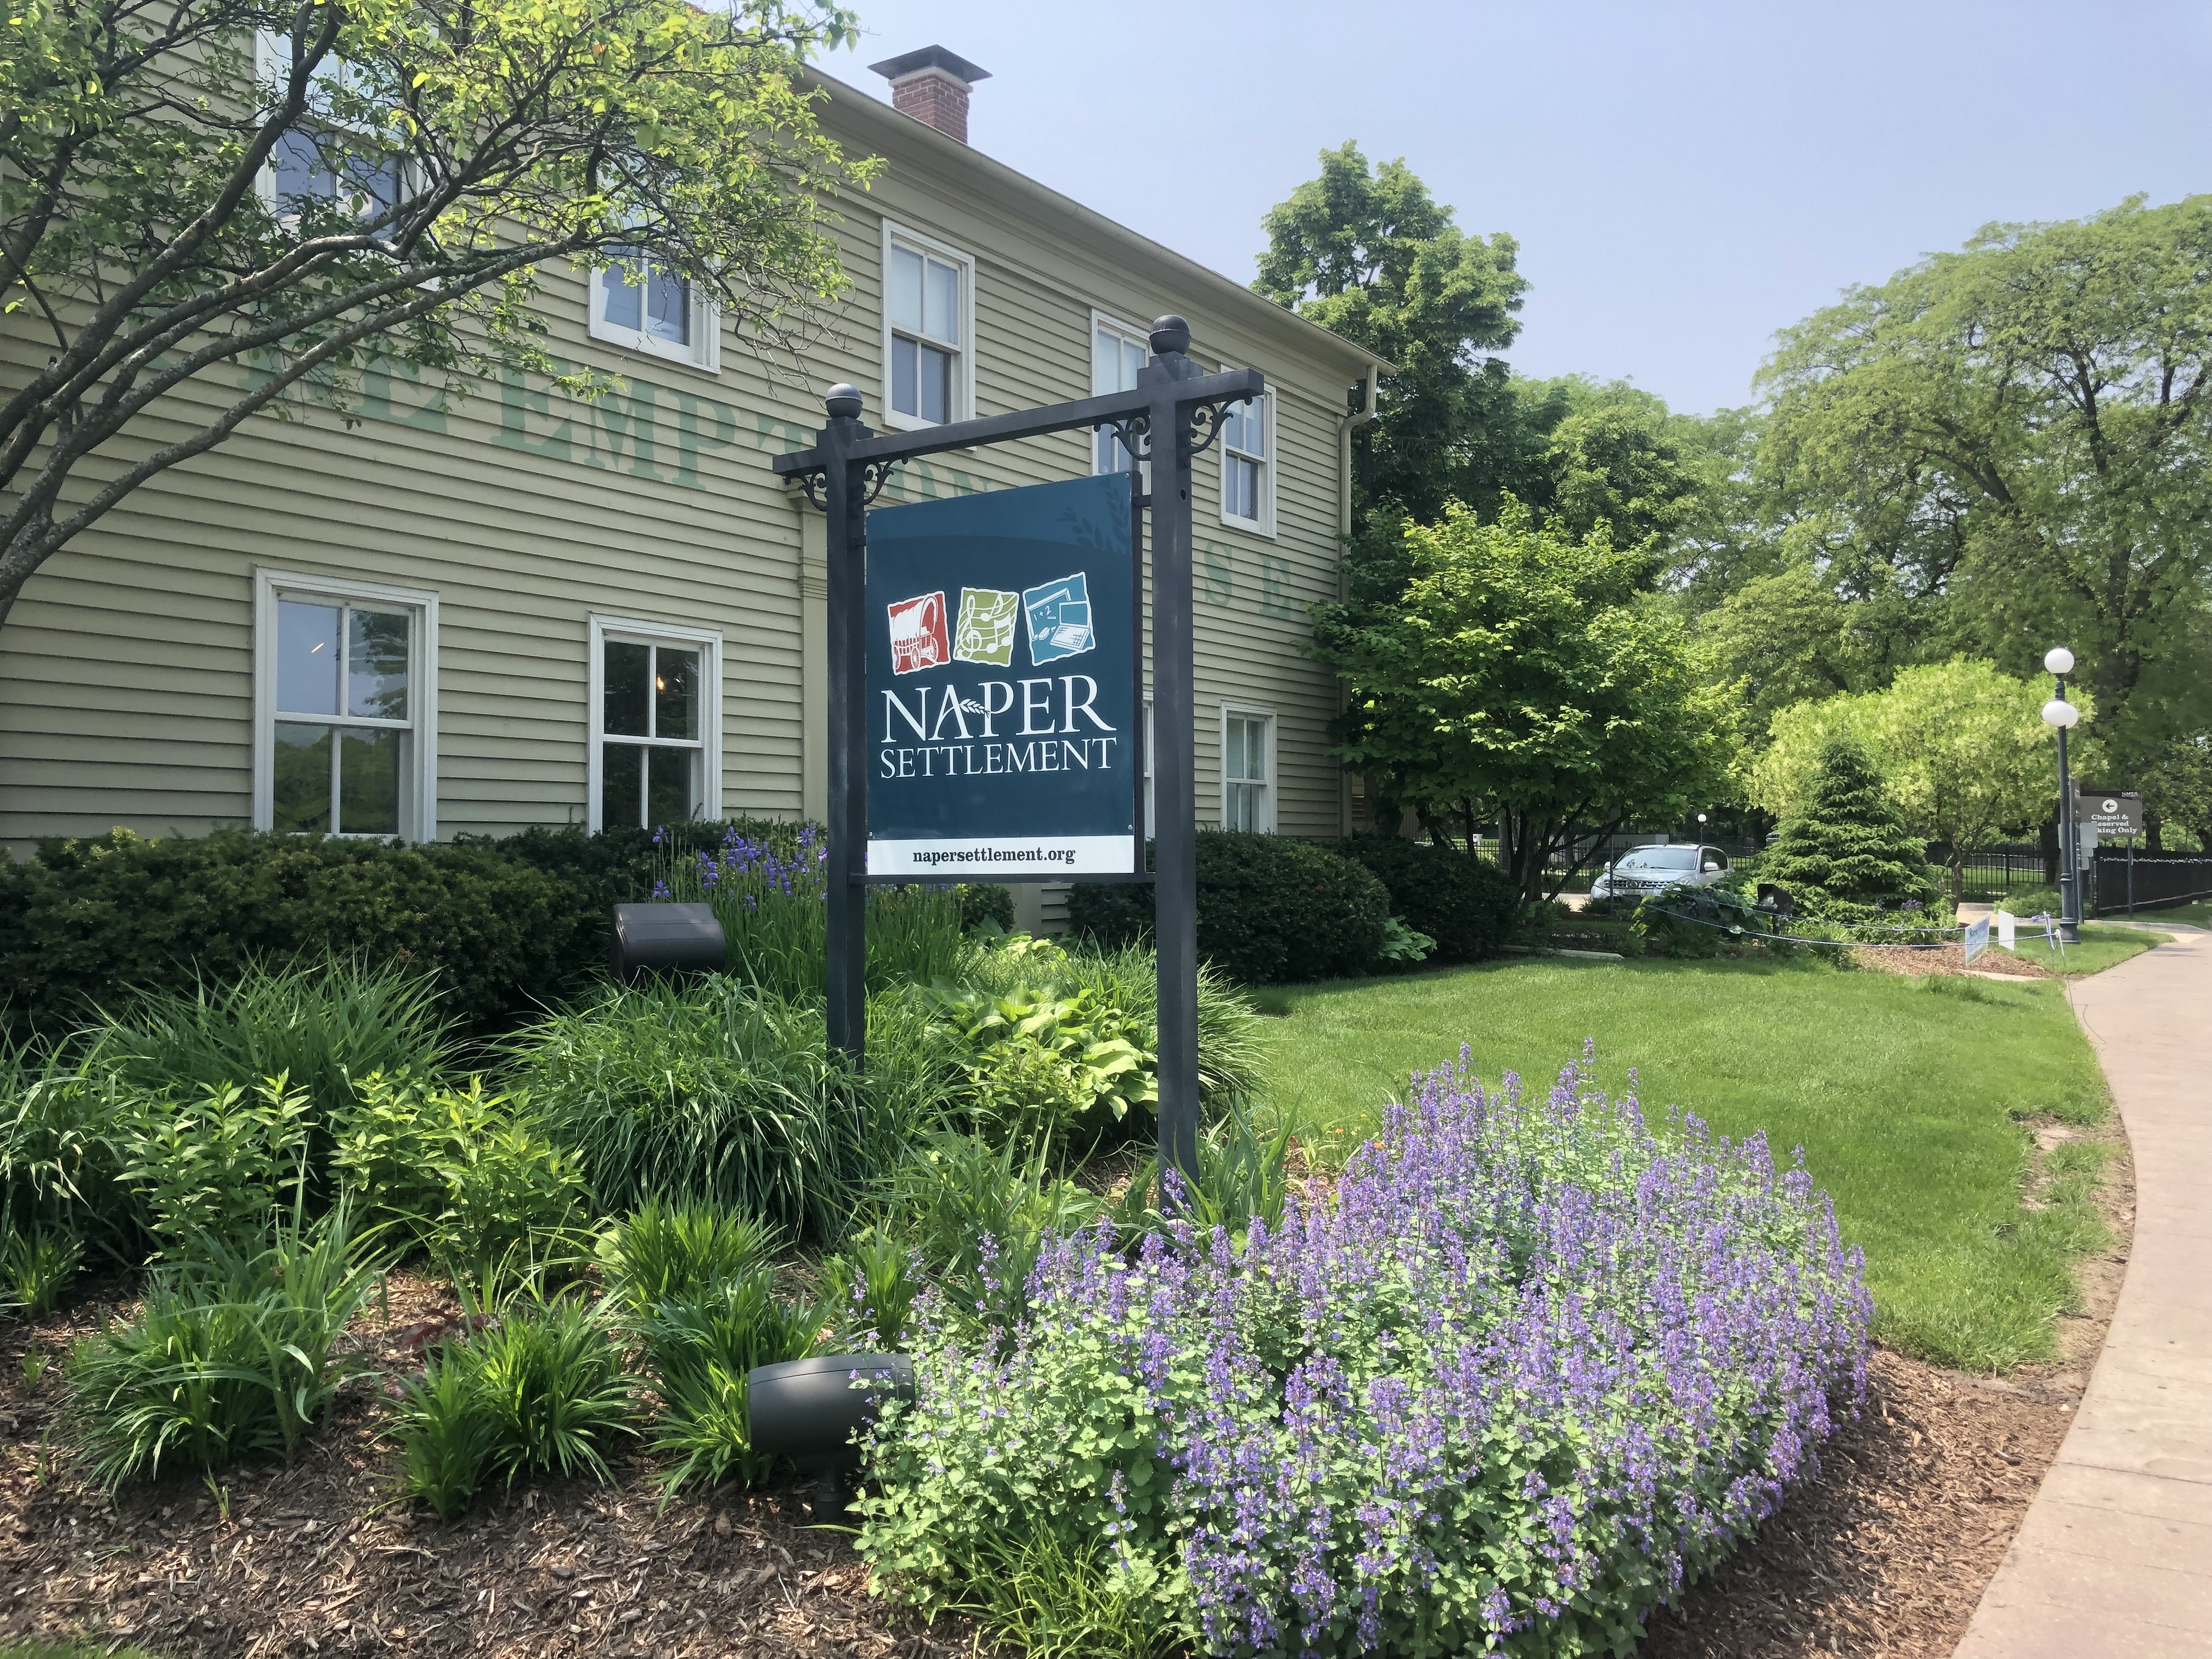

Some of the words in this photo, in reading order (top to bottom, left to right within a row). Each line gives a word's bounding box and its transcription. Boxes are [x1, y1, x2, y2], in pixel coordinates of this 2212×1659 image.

[881, 675, 1118, 743] NAPER
[881, 737, 1117, 778] SETTLEMENT
[913, 847, 1076, 866] napersettlement.org
